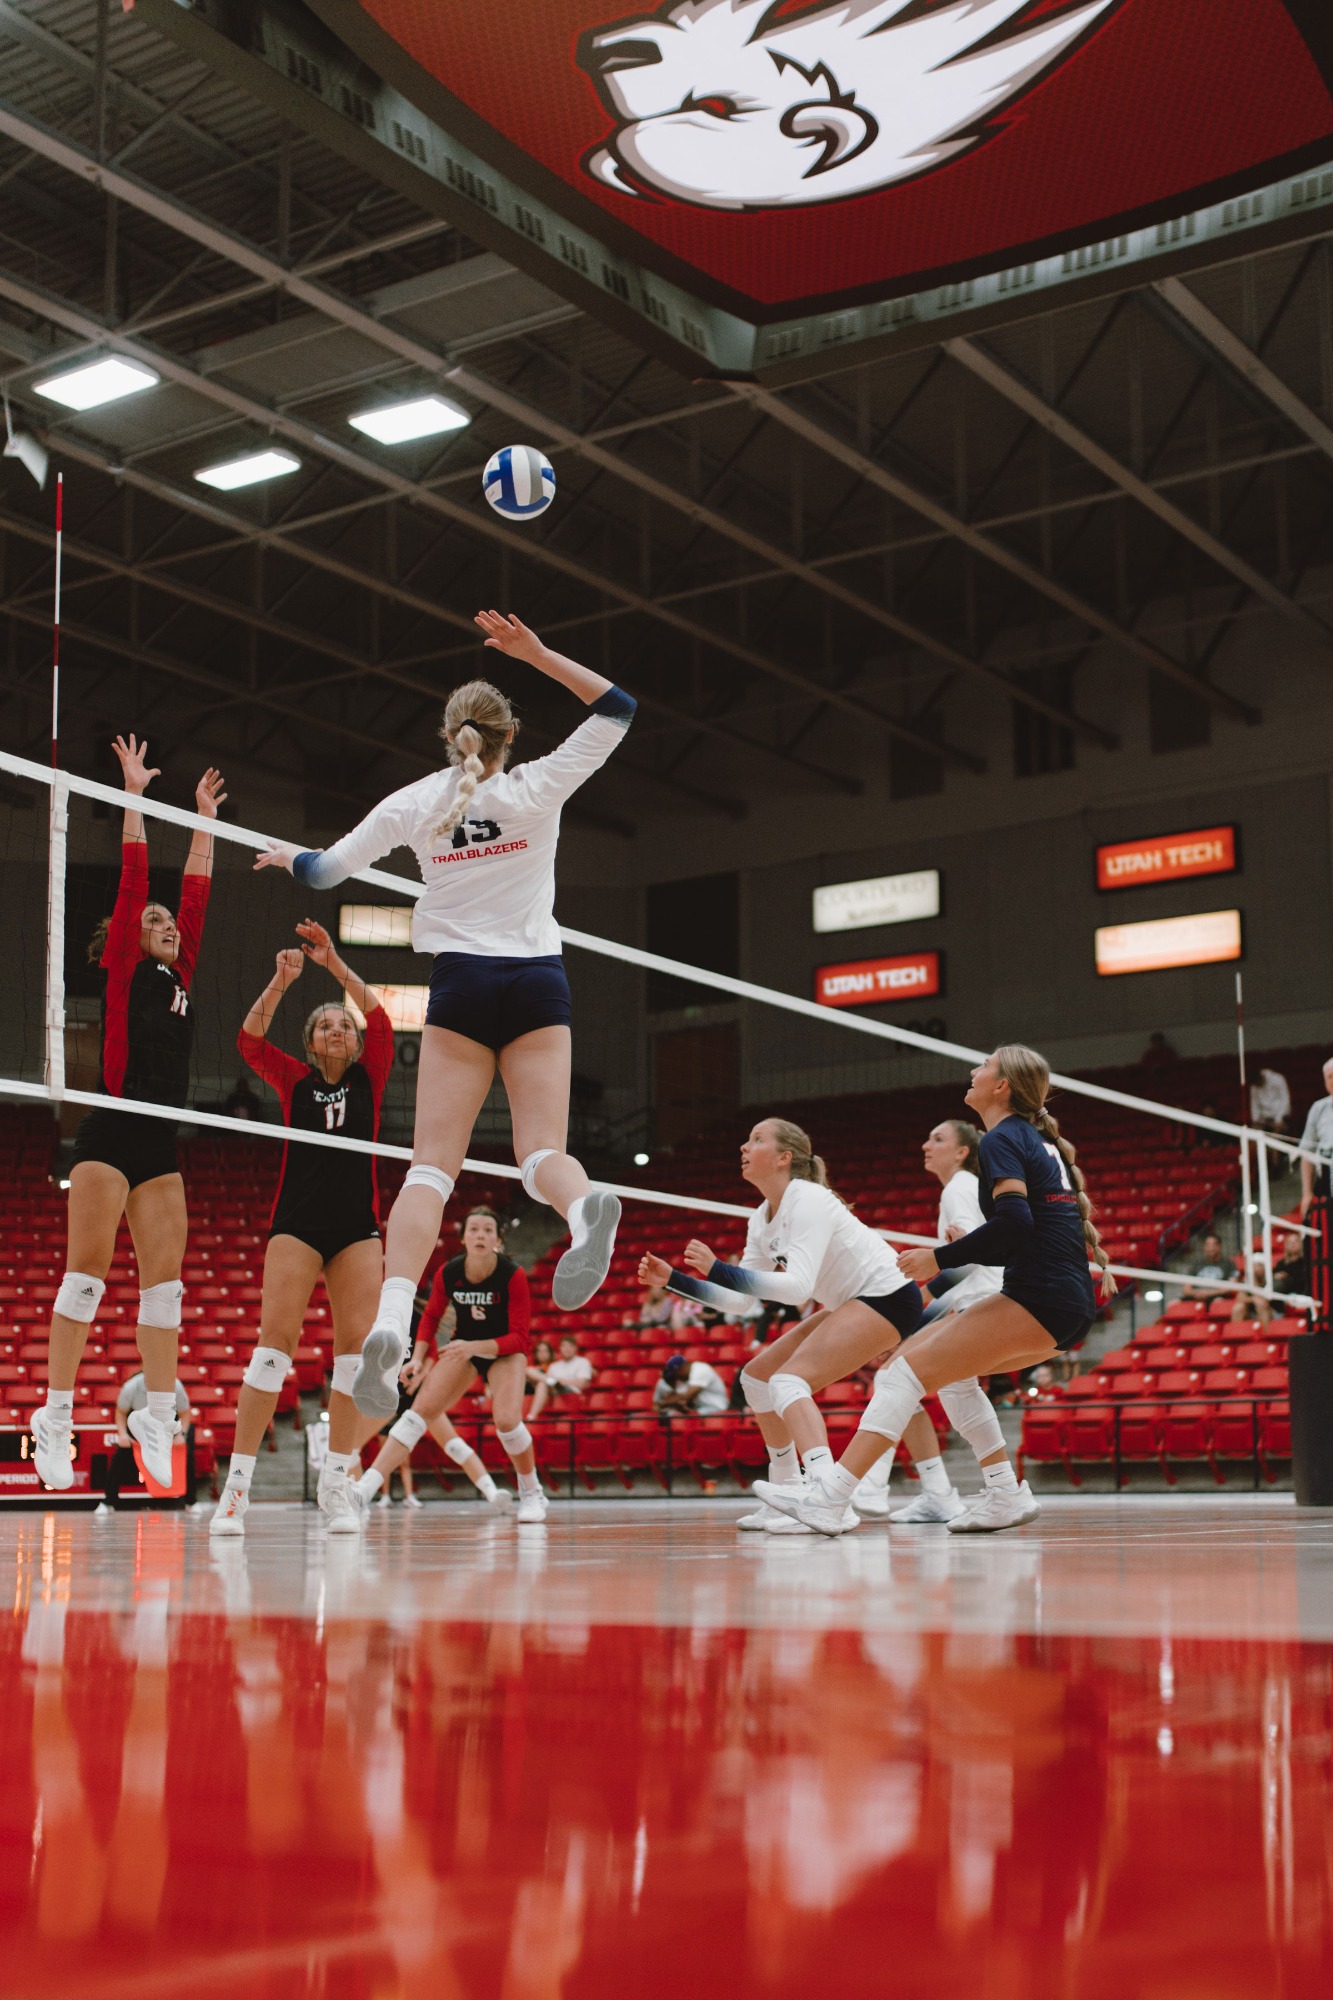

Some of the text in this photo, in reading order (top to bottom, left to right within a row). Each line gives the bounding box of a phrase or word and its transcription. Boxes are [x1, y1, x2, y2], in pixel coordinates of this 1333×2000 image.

[431, 839, 528, 864] TRAILBLAZERS
[1106, 840, 1223, 876] UTAH TECH
[823, 965, 927, 996] UTAH TECH
[324, 1094, 346, 1131] 17
[471, 1305, 486, 1320] 6
